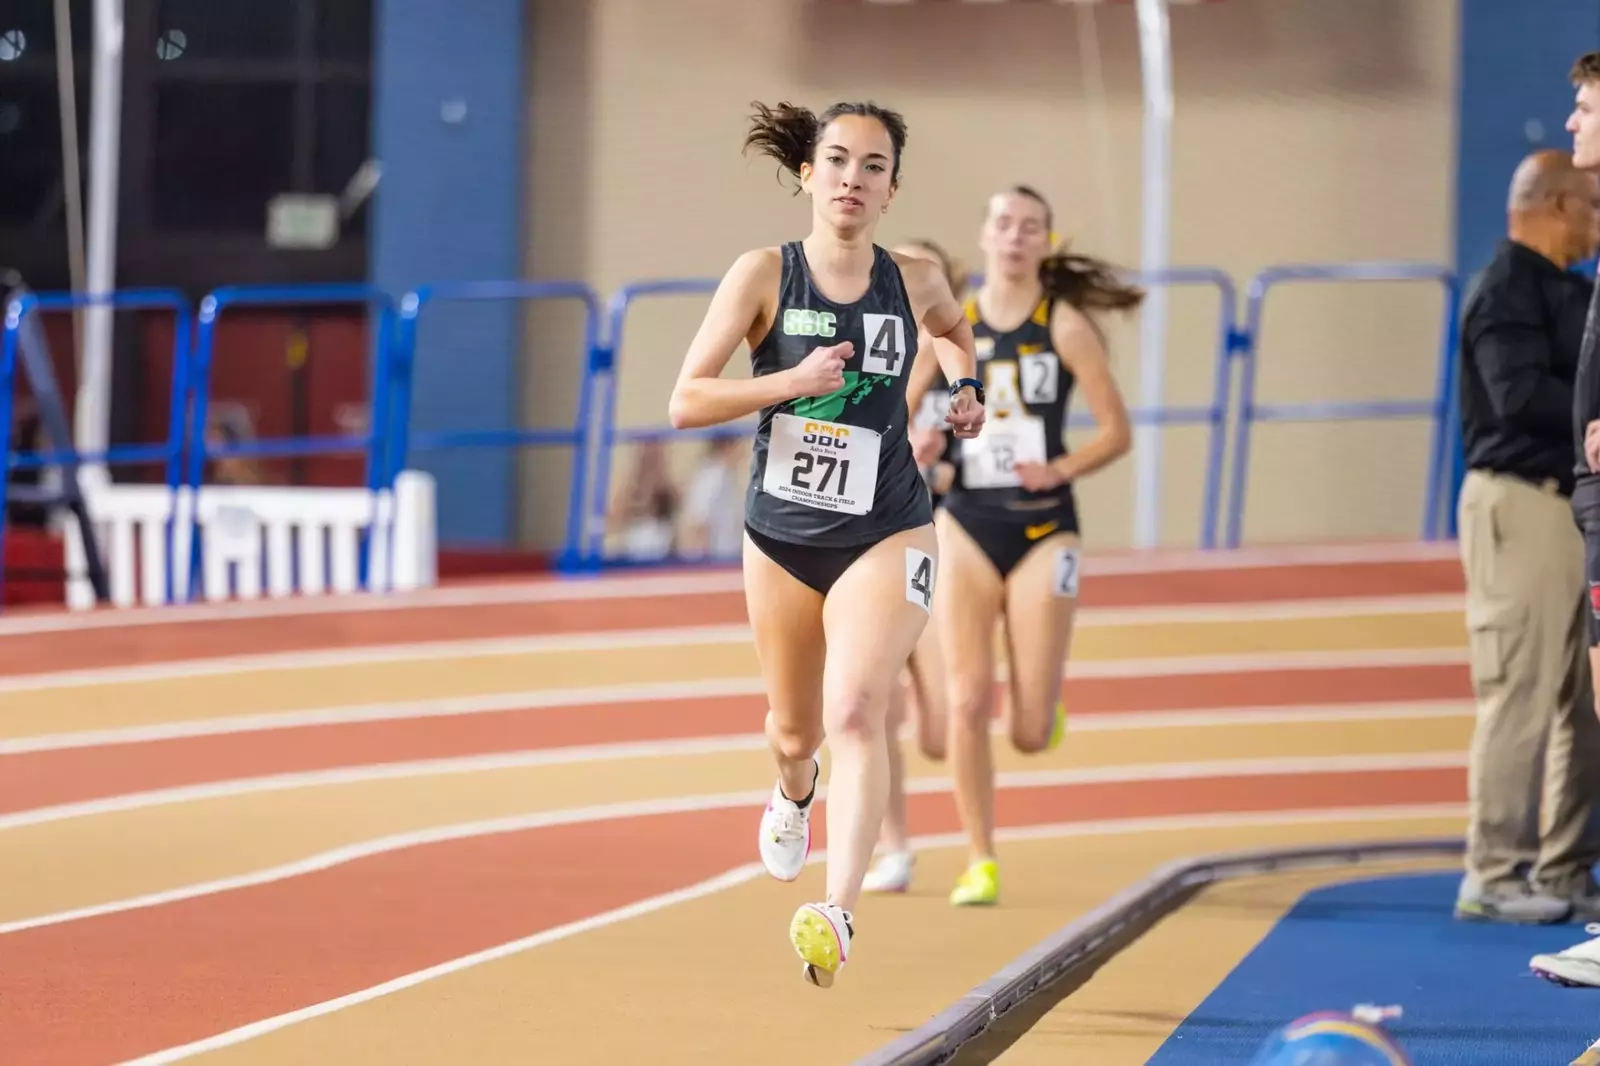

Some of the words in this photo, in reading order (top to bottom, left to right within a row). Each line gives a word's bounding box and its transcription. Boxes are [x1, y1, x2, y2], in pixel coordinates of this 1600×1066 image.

[783, 309, 837, 337] SBC
[870, 319, 900, 371] 4
[1033, 361, 1052, 400] 2
[803, 422, 850, 449] SBC
[791, 451, 850, 496] 271
[791, 495, 838, 509] CHAMPIONSHIPS
[792, 489, 813, 498] INDOOR
[813, 494, 833, 503] TRACK
[838, 498, 855, 506] FIELD
[911, 556, 932, 608] 4
[1059, 552, 1076, 593] 2
